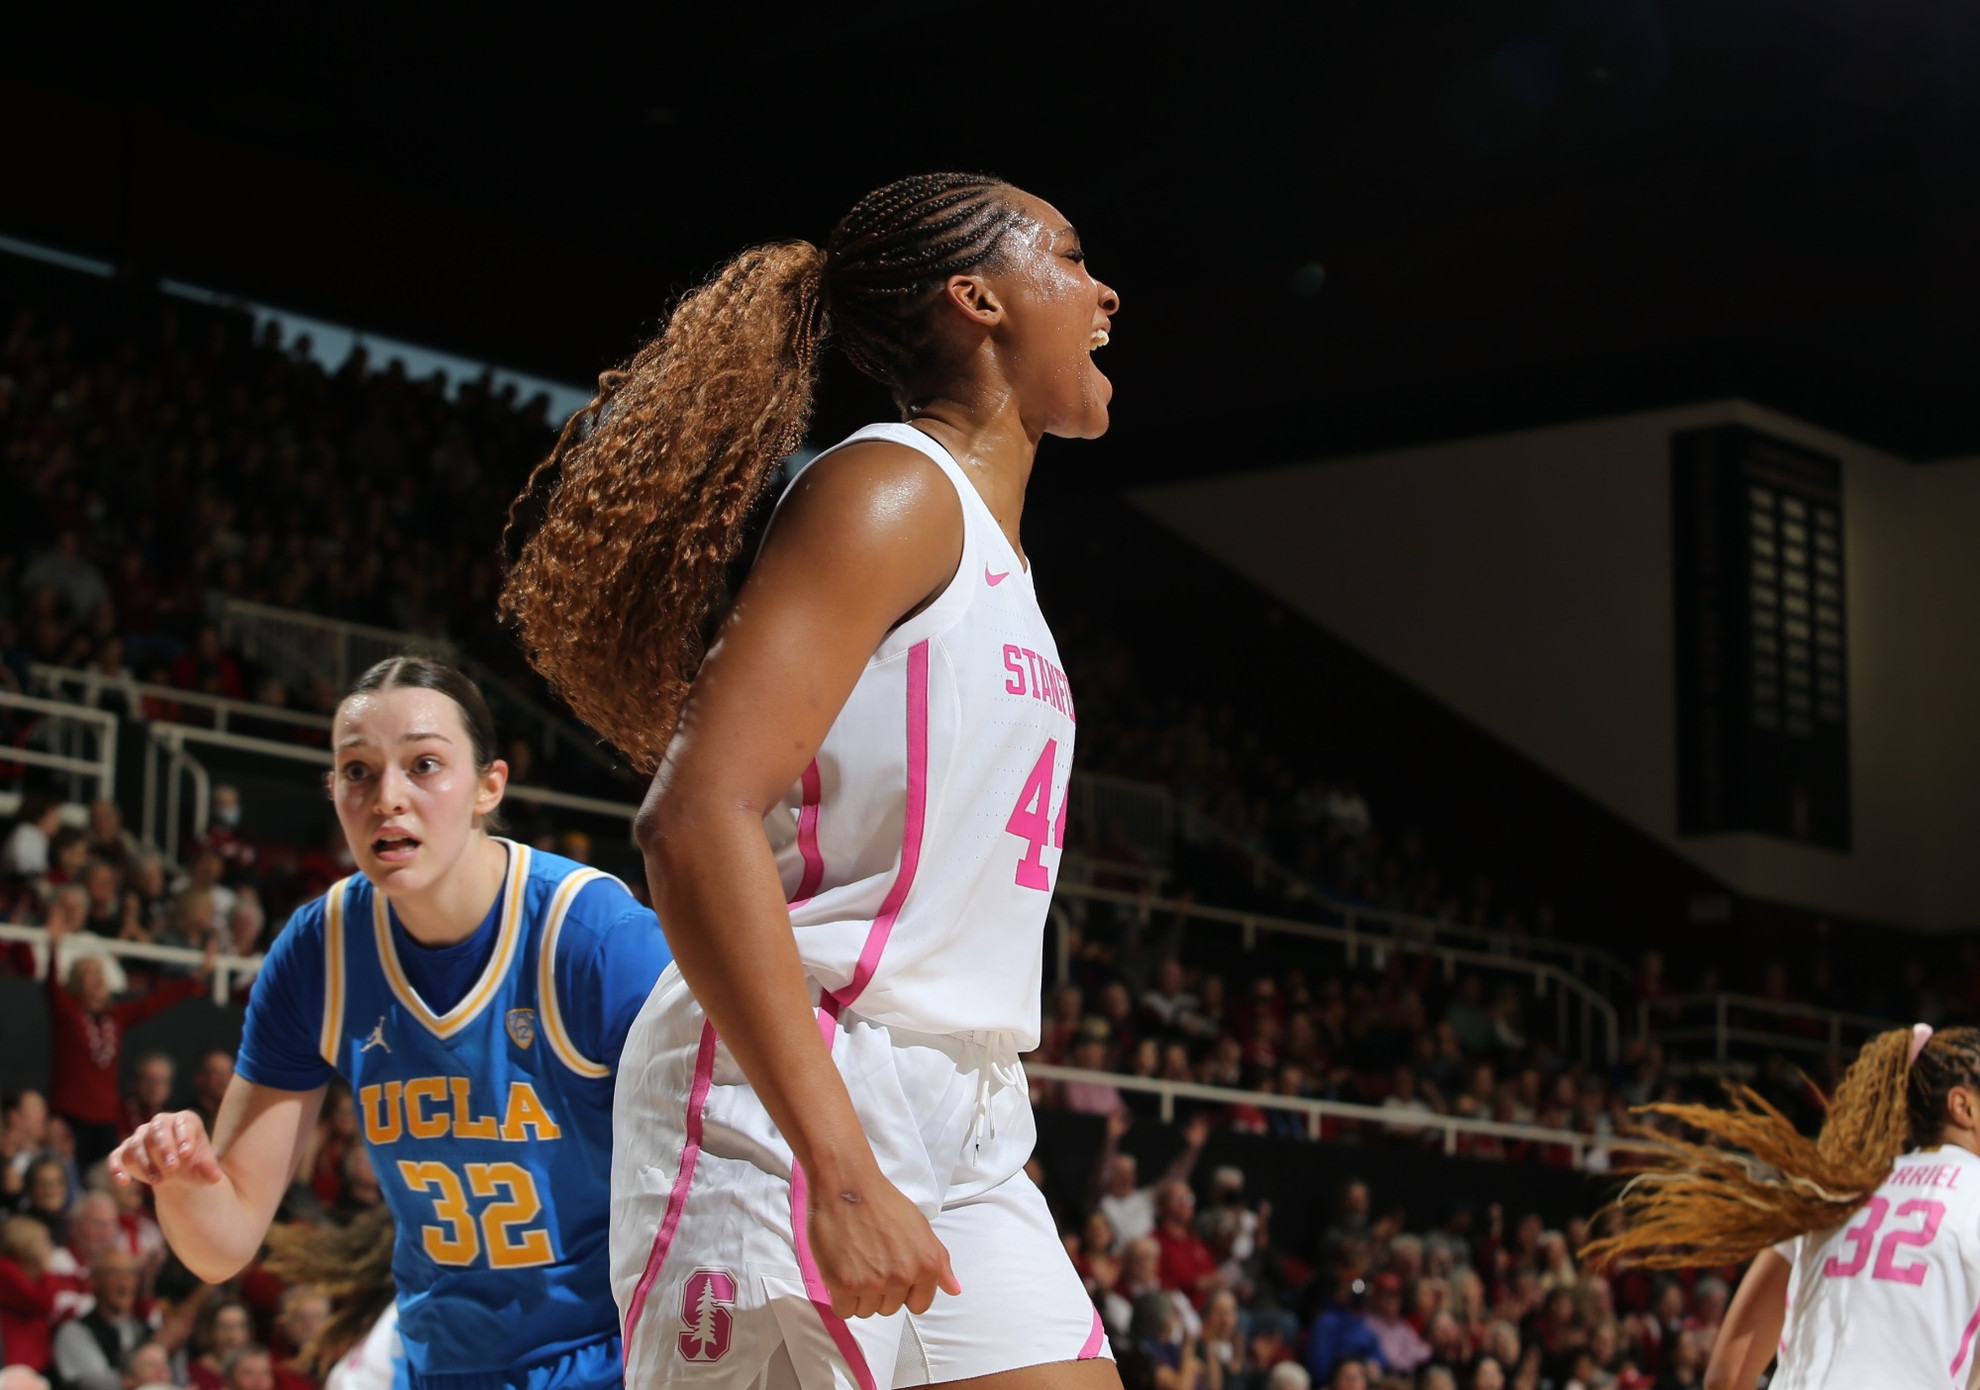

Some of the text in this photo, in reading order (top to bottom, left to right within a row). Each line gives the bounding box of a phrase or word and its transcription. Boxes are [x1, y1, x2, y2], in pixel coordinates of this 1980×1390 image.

[360, 1076, 562, 1145] UCLA
[397, 1160, 556, 1269] 32
[1886, 1164, 1961, 1190] RRIEL
[1824, 1196, 1946, 1286] 32
